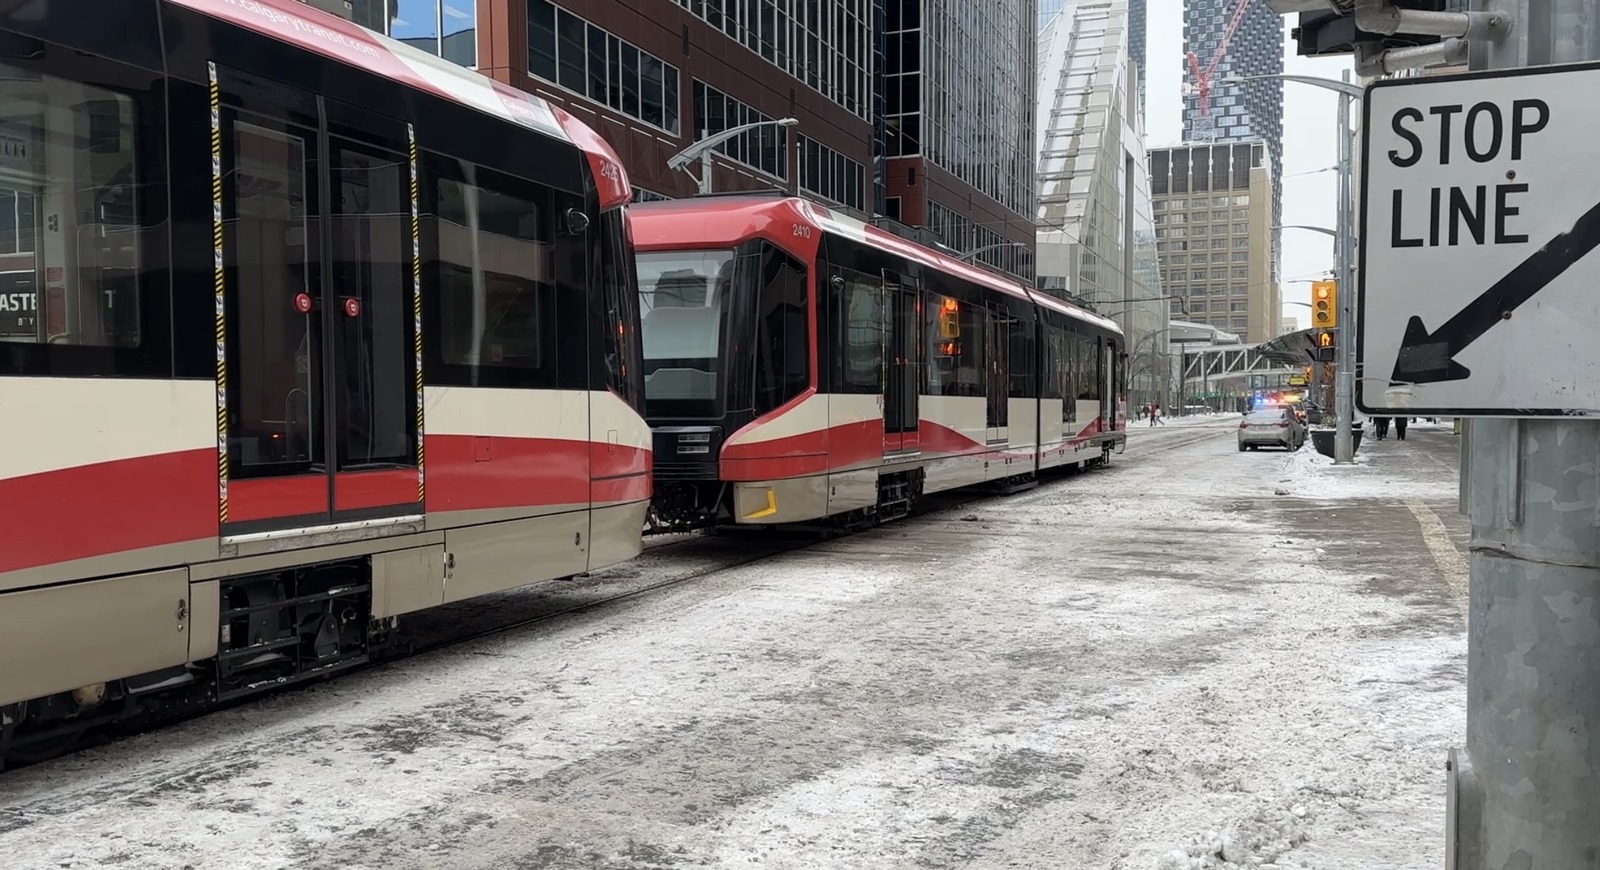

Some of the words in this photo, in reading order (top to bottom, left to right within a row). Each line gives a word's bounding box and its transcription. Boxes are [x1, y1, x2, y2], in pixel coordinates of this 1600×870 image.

[1388, 98, 1550, 168] STOP
[792, 223, 811, 239] 2410
[1391, 183, 1529, 248] LINE
